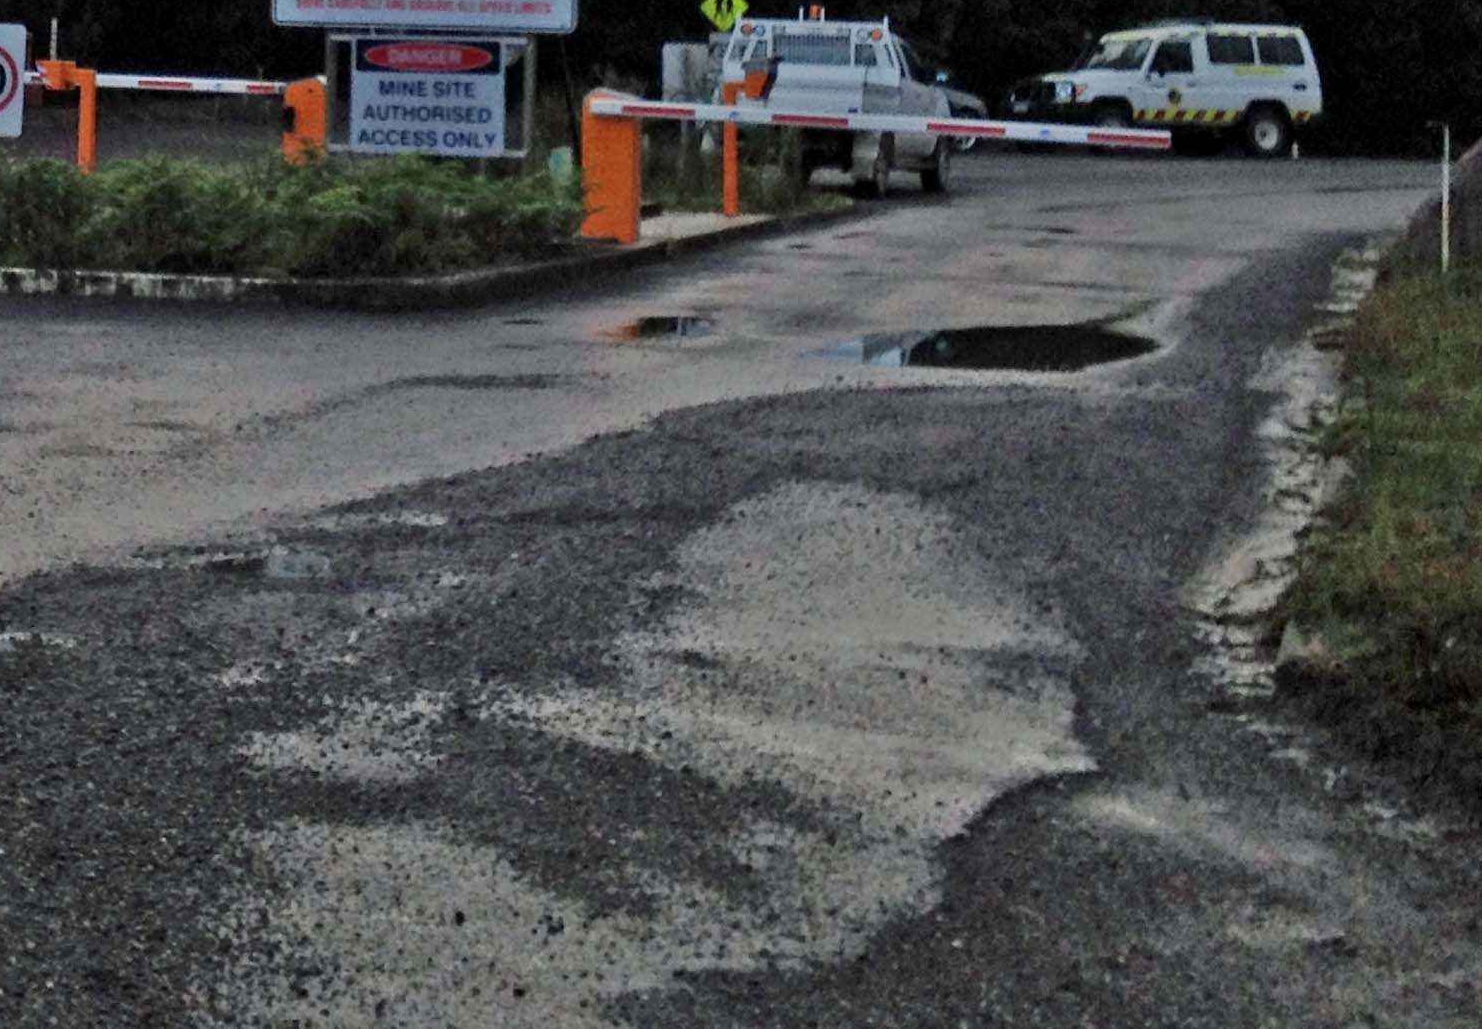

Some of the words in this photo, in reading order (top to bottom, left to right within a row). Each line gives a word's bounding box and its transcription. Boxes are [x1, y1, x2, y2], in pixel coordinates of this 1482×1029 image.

[387, 50, 463, 64] DANGER
[379, 80, 428, 96] MINE
[433, 81, 476, 98] SITE
[363, 105, 492, 123] AUTHORISED
[358, 130, 438, 147] ACCESS
[443, 131, 497, 148] ONLY
